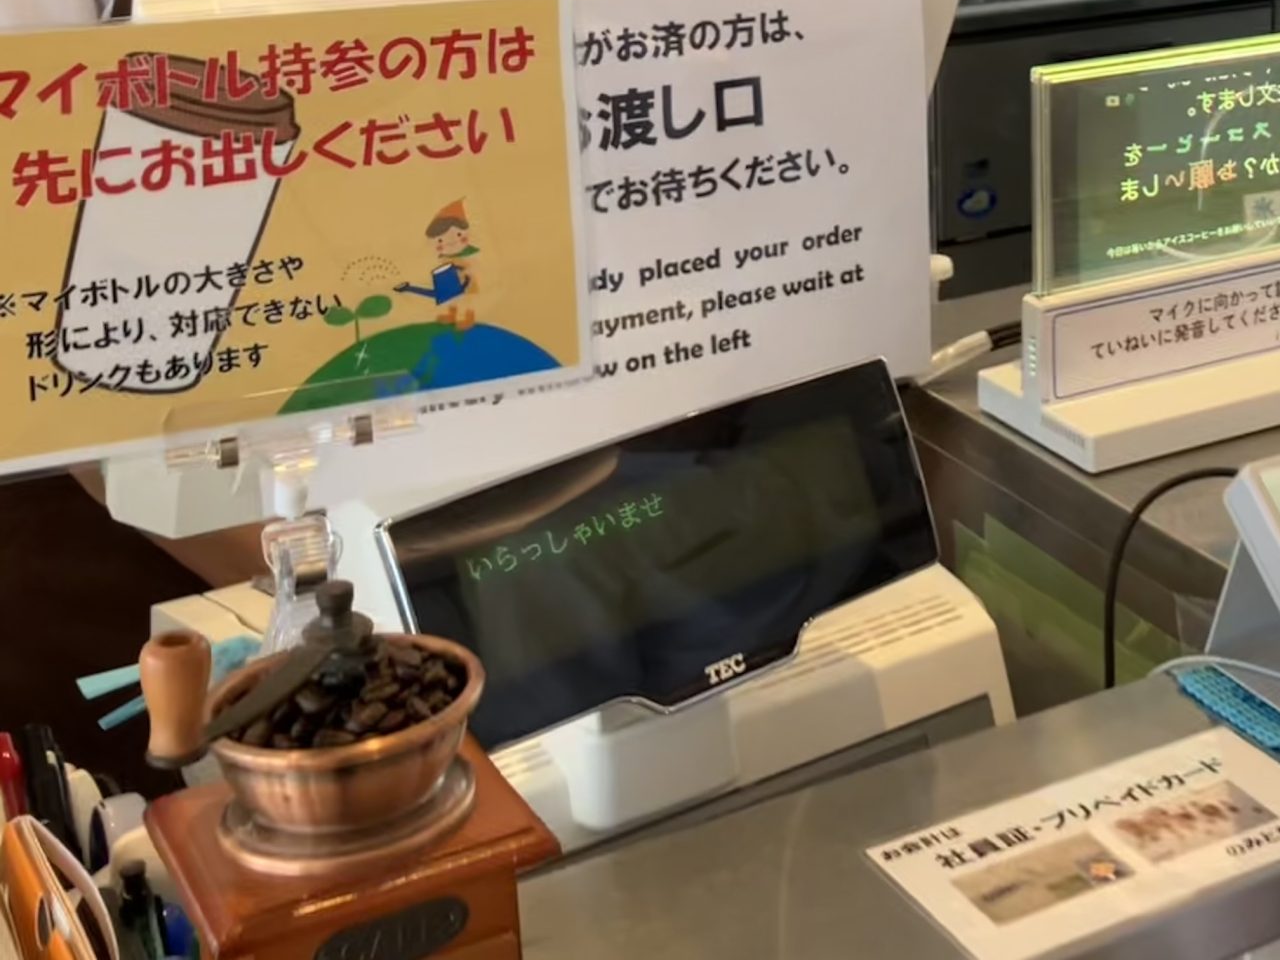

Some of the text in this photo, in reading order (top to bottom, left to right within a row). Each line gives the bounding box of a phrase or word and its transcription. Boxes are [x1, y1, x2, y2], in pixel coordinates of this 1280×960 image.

[0, 25, 535, 120] マイボトル持参の方は
[11, 106, 516, 208] 先にお出しください
[585, 148, 851, 214] でお待ちください。
[0, 255, 304, 318] ※マイボトルの大きさや
[639, 247, 721, 288] placed
[733, 239, 789, 268] your
[801, 223, 863, 253] order
[700, 281, 778, 315] please
[782, 269, 835, 298] wait
[839, 264, 865, 287] at
[25, 294, 344, 361] 形により、対応できない
[625, 351, 656, 375] on
[662, 336, 704, 367] the
[710, 327, 752, 359] left
[28, 344, 270, 403] ドリンクもあります
[465, 493, 665, 579] いらっしゃいませ
[704, 653, 747, 684] TEC
